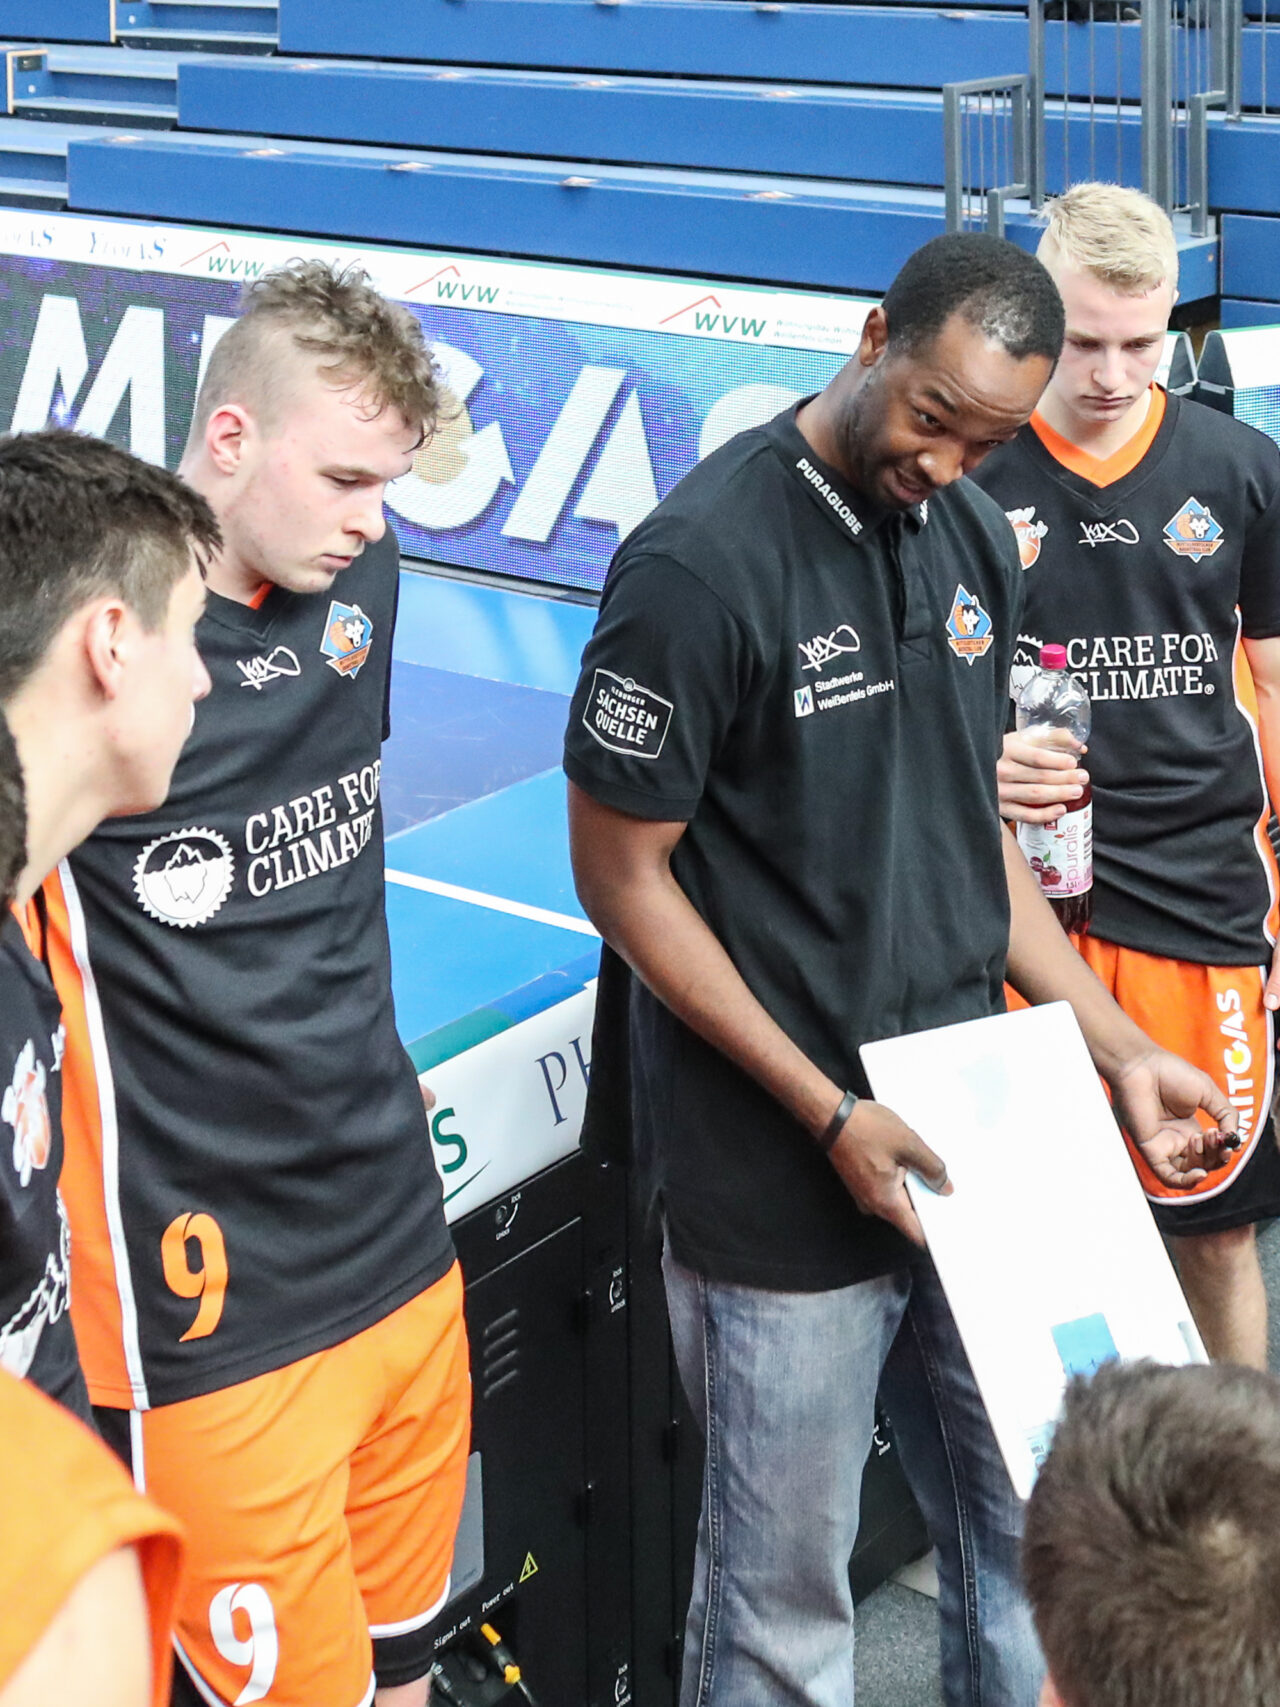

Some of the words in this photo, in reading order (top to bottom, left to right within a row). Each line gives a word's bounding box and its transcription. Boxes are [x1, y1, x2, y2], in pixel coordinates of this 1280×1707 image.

[436, 280, 499, 303] WVW
[695, 312, 767, 338] WVW
[796, 457, 863, 535] PURAGLOBE
[1066, 635, 1156, 669] CARE
[1161, 633, 1219, 664] FOR
[814, 671, 864, 693] Stadtwerke
[866, 680, 895, 696] GmbH
[596, 688, 658, 730] SACHSEN
[595, 709, 648, 746] QUELLE
[245, 785, 337, 855] CARE
[1064, 823, 1080, 882] puralis
[161, 1211, 229, 1343] 9
[481, 1593, 501, 1613] Power
[502, 1582, 514, 1596] out
[209, 1582, 278, 1706] 9
[433, 1625, 457, 1650] Signal
[459, 1616, 471, 1630] out
